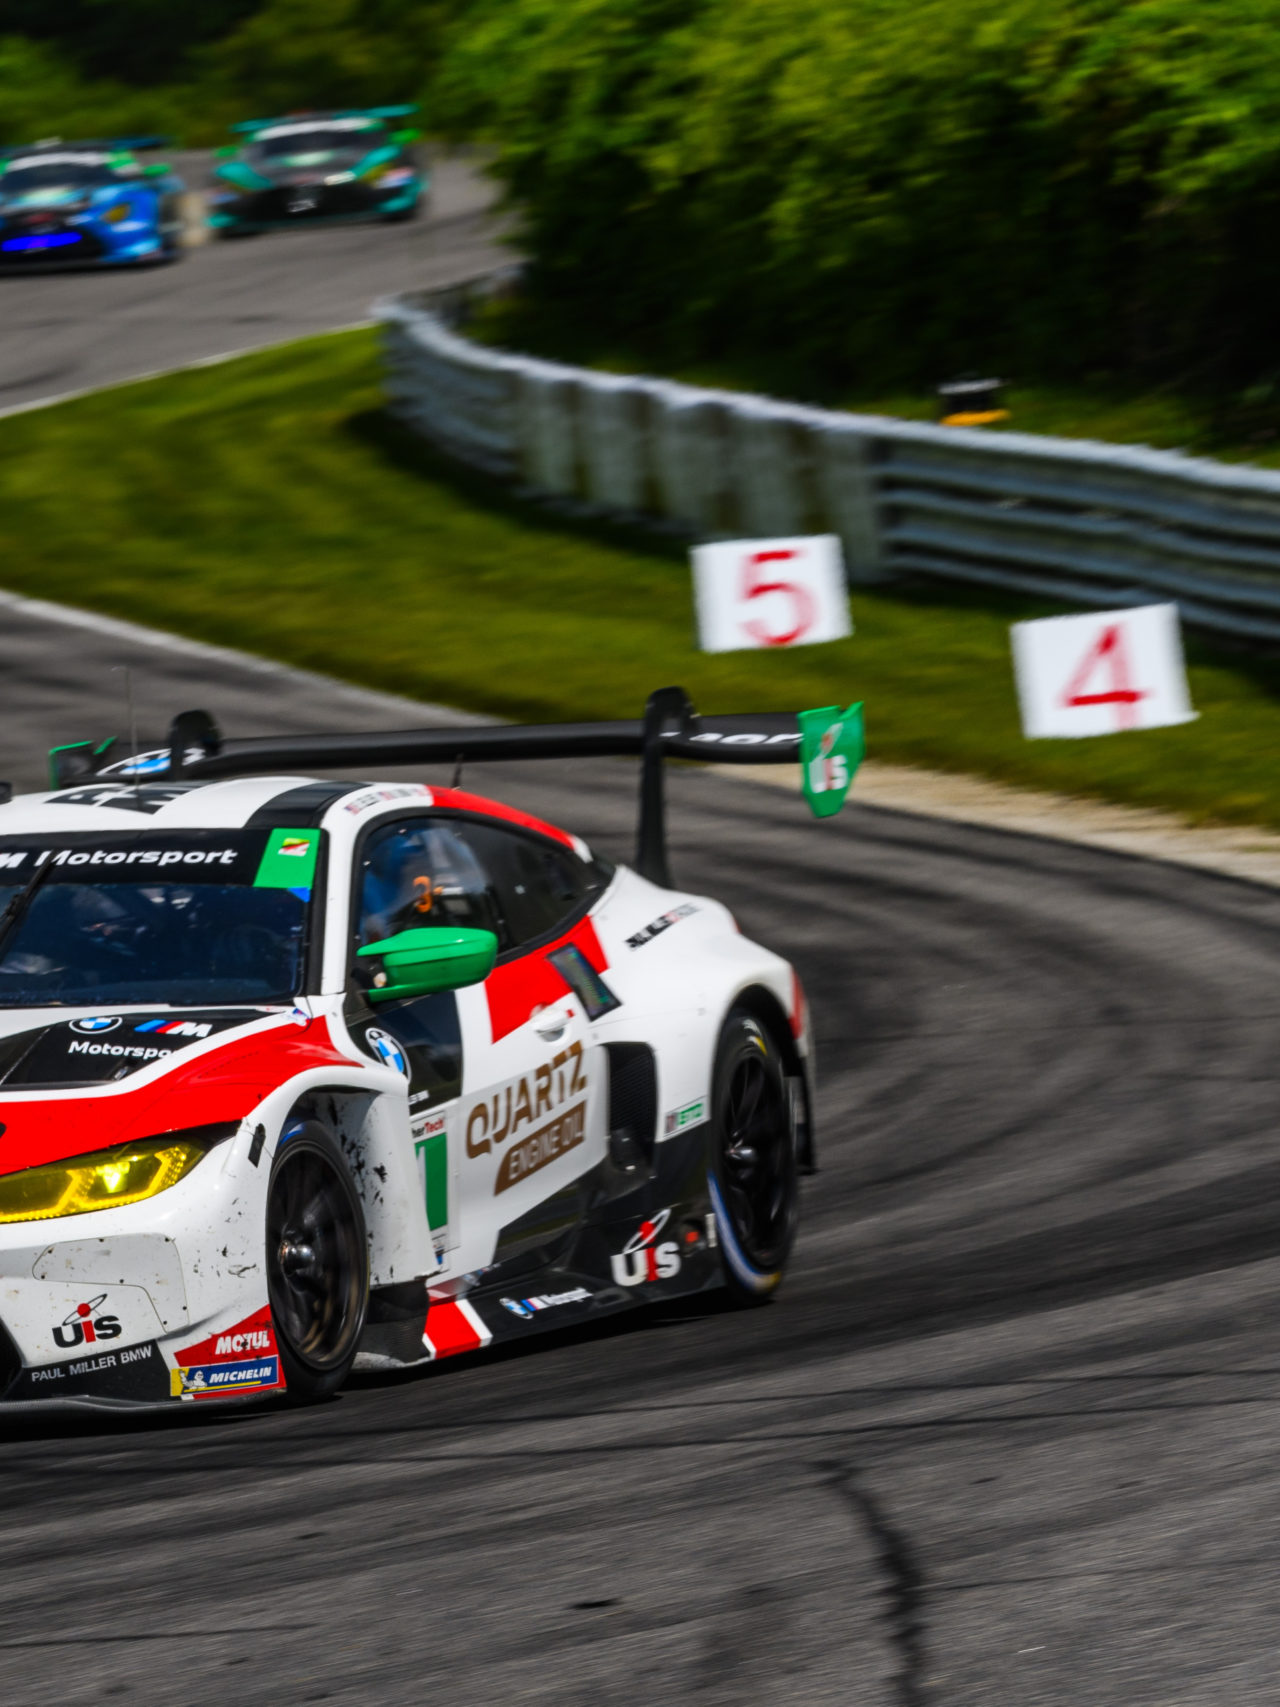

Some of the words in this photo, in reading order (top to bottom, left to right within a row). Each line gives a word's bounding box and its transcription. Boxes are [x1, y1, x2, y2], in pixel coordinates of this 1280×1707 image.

[740, 548, 818, 646] 5
[1058, 624, 1149, 730] 4
[34, 849, 238, 867] Motorsport
[68, 1040, 177, 1060] Motorspo
[465, 1040, 587, 1159] QUARTZ
[507, 1125, 560, 1181] ENGINE
[215, 1330, 270, 1355] MOTUL
[31, 1367, 65, 1383] PAUL
[69, 1355, 117, 1376] MILLER
[120, 1346, 152, 1365] BMW
[209, 1365, 272, 1385] MICHELIN
